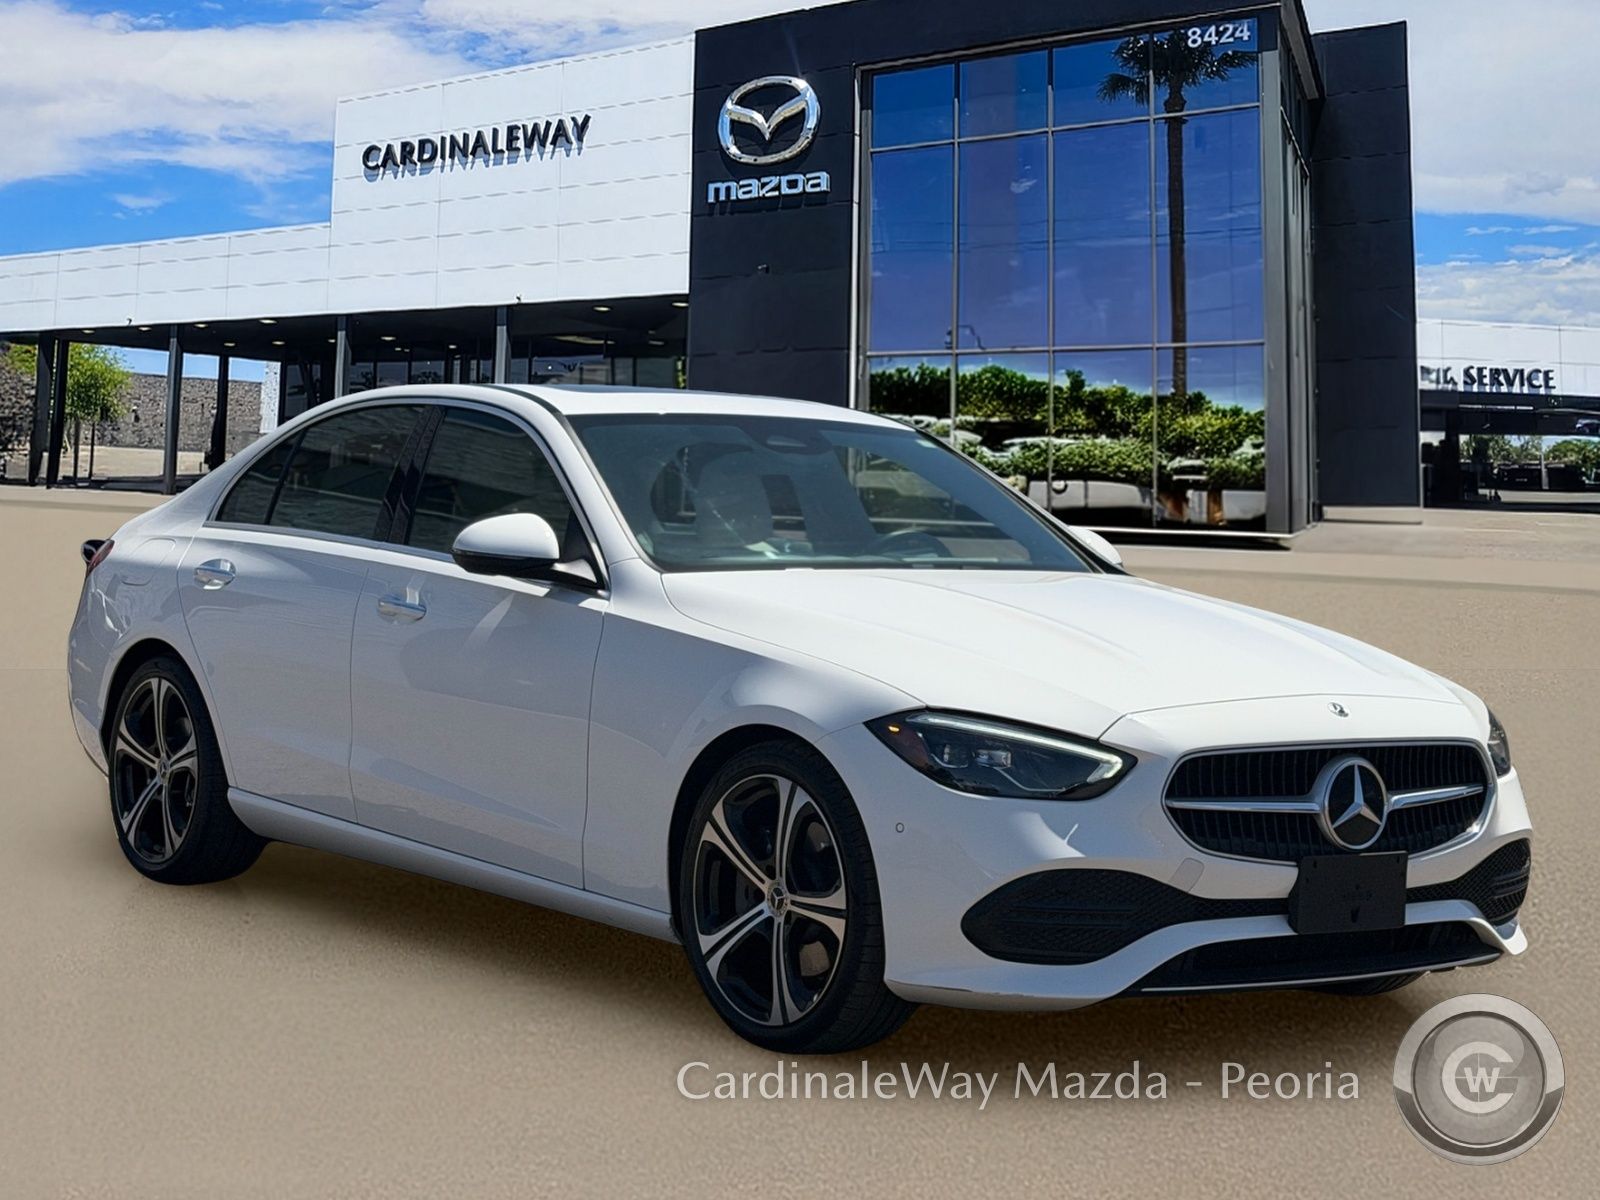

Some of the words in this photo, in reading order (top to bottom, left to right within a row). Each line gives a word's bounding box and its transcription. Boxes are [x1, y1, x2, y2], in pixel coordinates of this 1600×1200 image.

[1187, 21, 1251, 48] 8424
[361, 114, 592, 171] CARDINALEWAY
[1463, 365, 1556, 390] SERVICE
